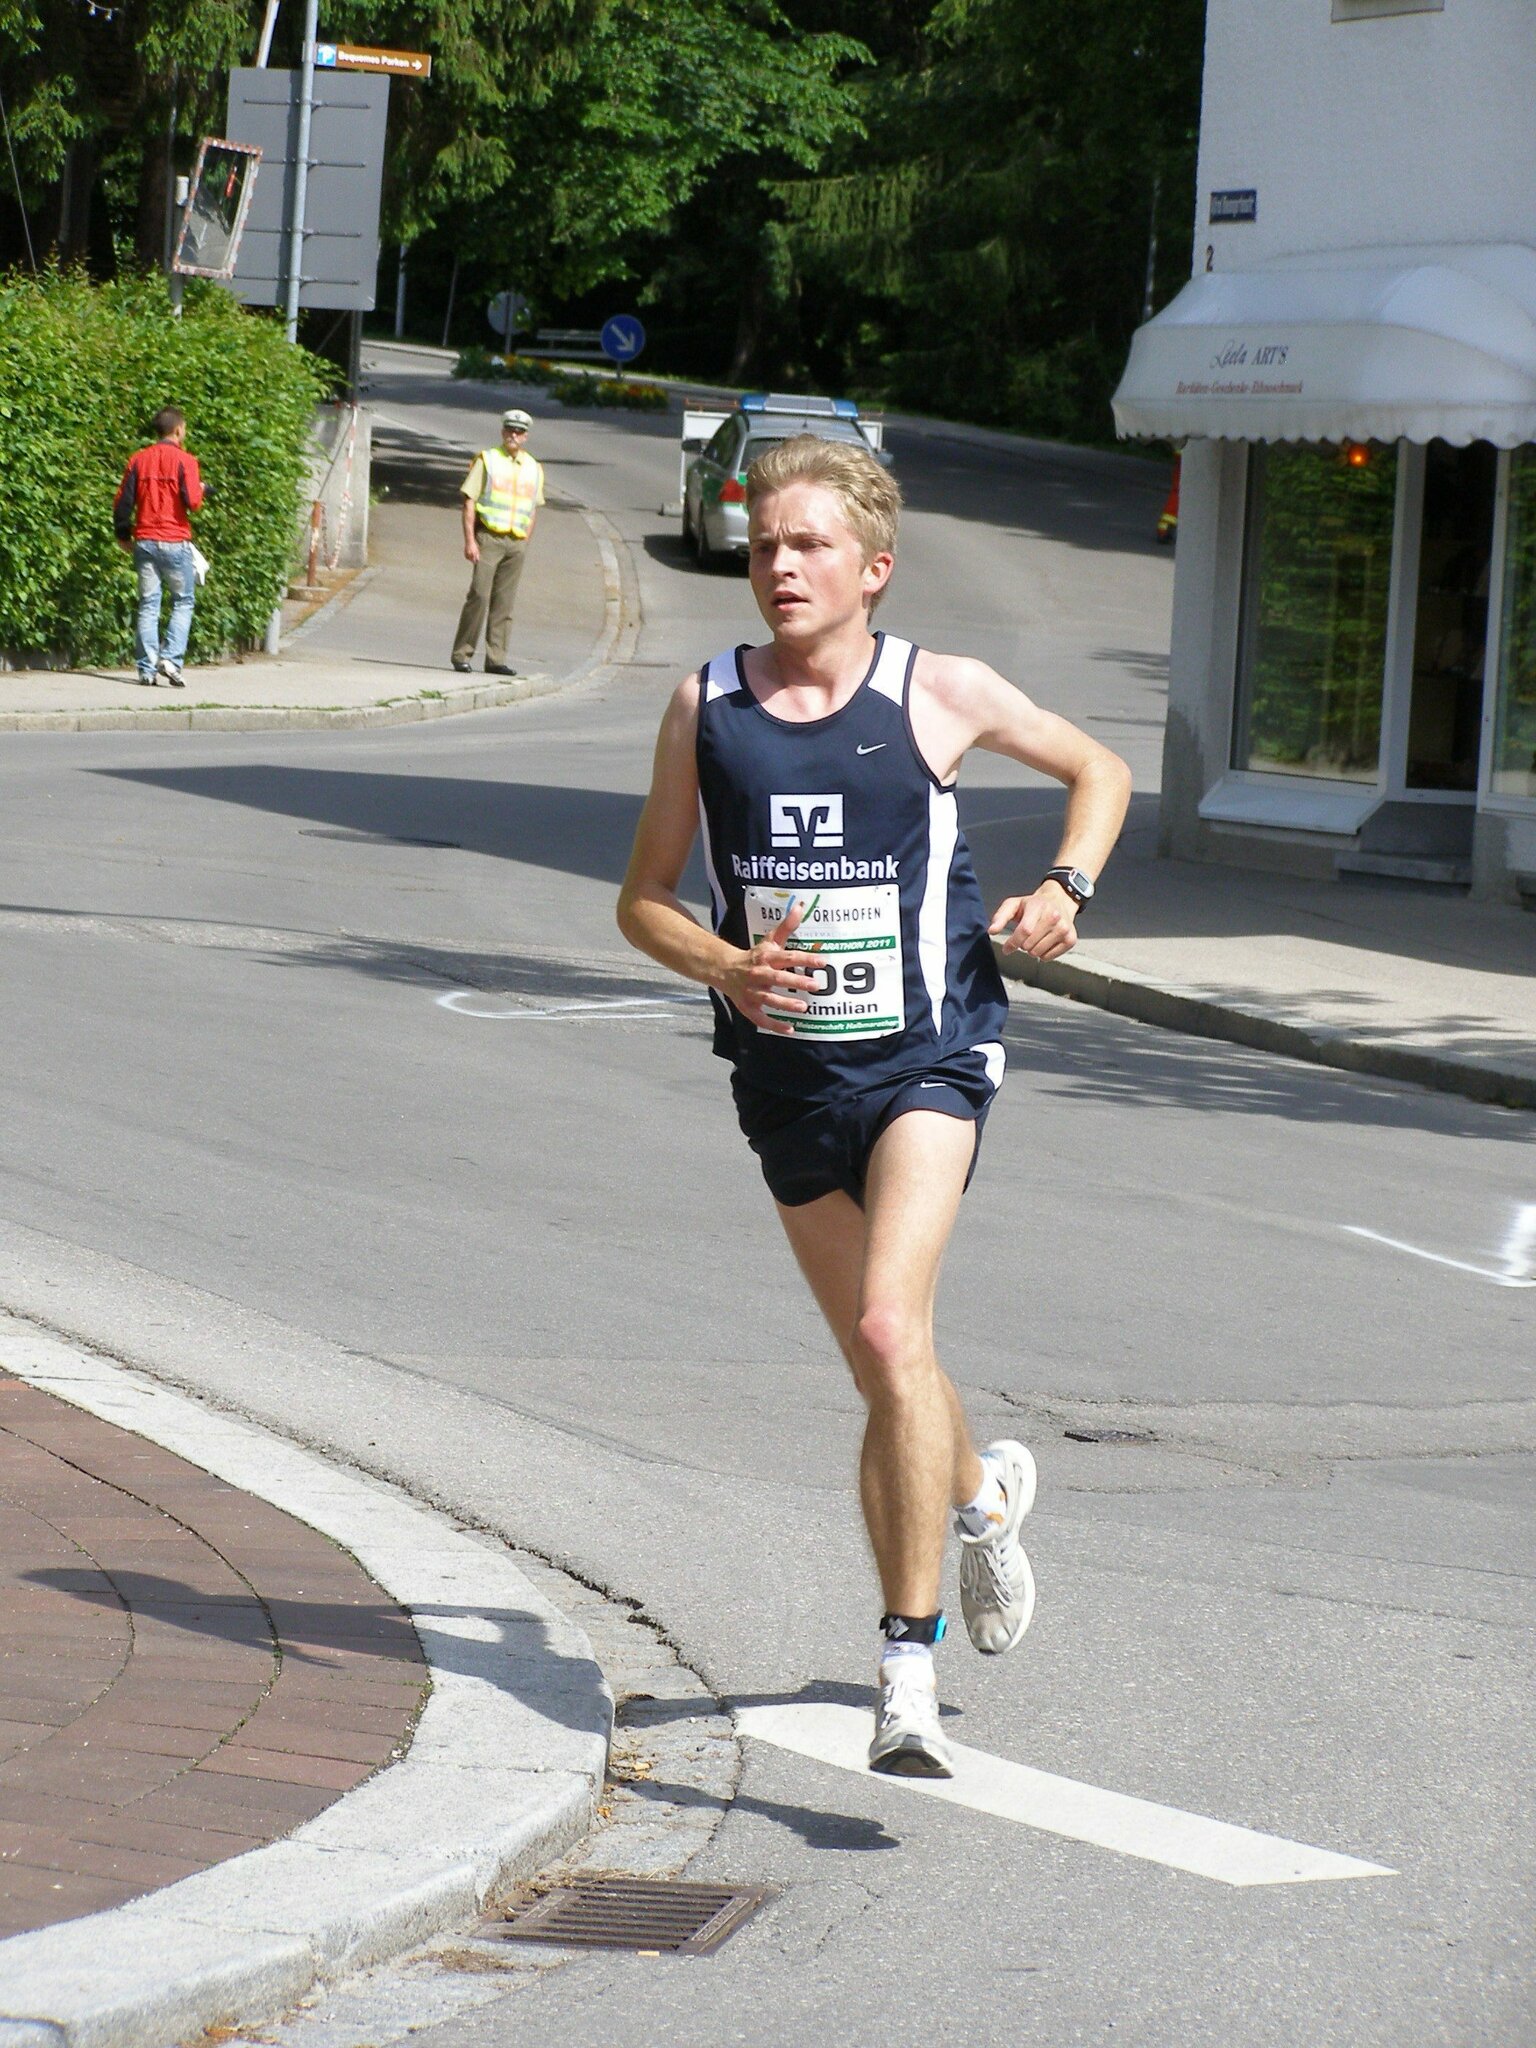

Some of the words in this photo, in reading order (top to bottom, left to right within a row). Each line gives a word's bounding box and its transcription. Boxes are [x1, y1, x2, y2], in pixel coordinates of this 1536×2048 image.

[1206, 245, 1214, 272] 2
[732, 854, 900, 881] Raiffeisenbank
[761, 906, 782, 921] BAD
[865, 938, 891, 949] 2011
[786, 961, 876, 997] 09
[799, 1001, 879, 1016] ximilian
